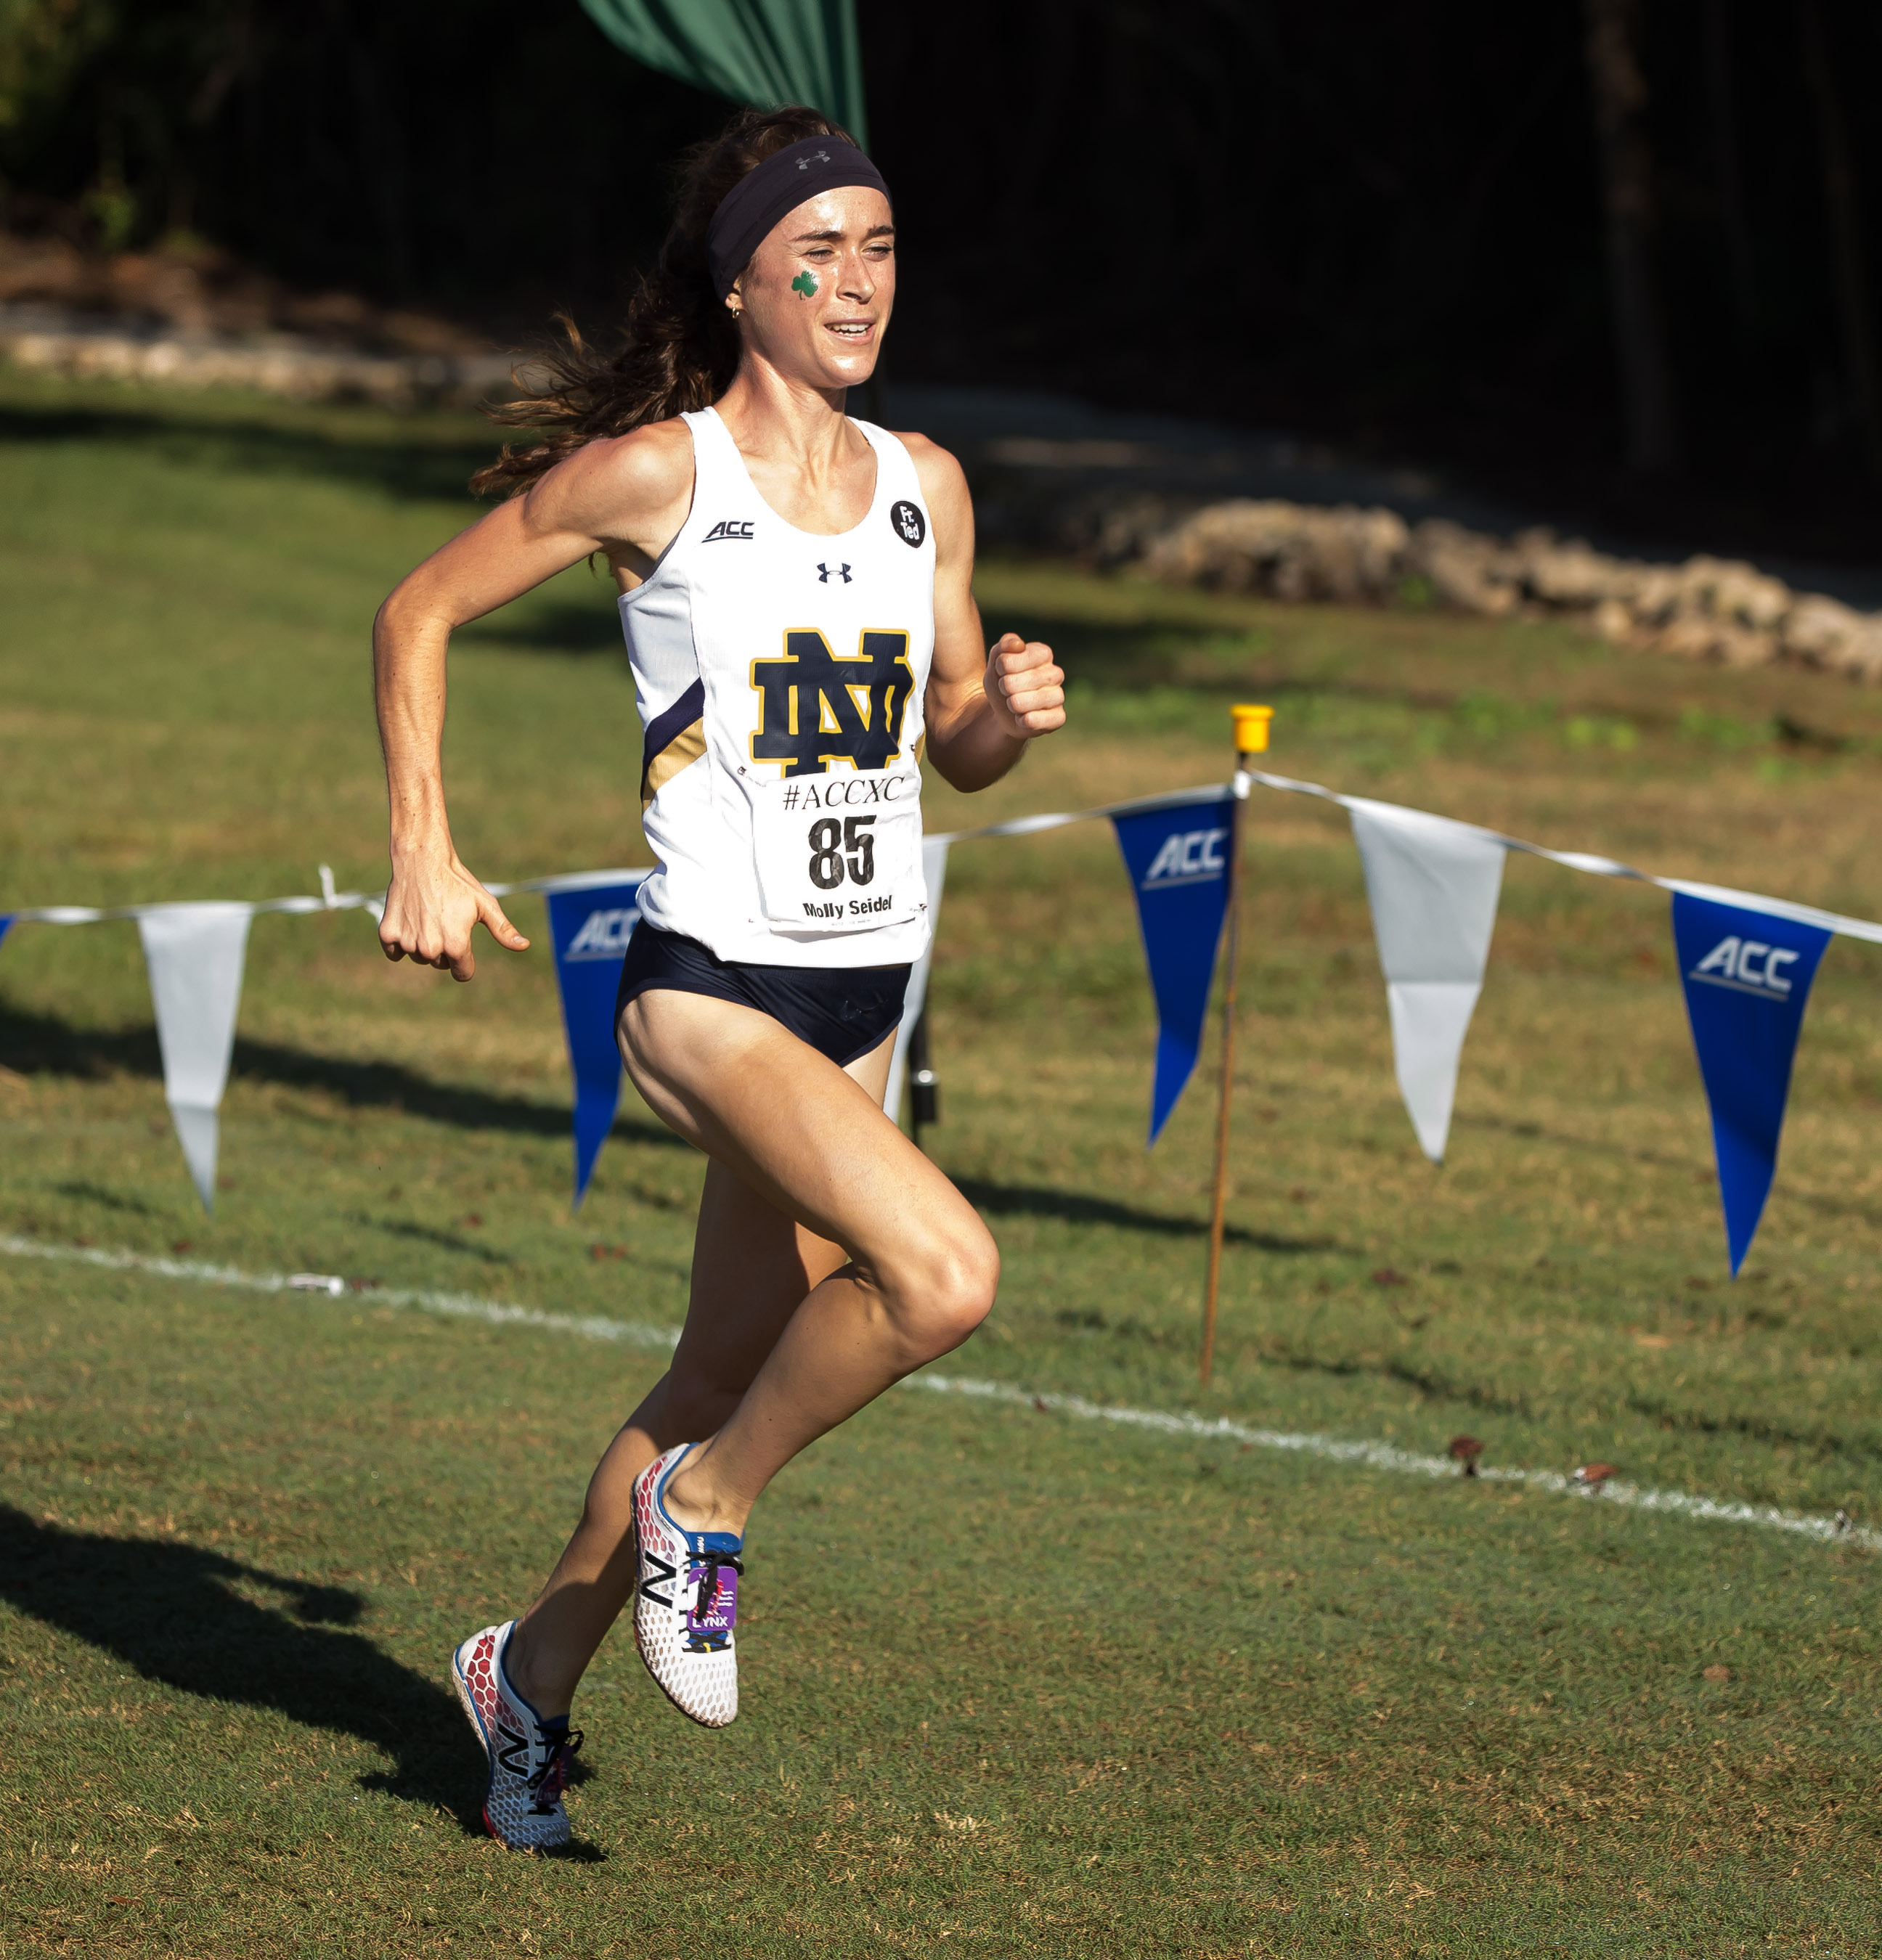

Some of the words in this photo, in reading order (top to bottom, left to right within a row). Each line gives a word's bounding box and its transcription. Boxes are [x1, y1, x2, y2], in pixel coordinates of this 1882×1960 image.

[705, 521, 754, 539] ACC
[900, 521, 920, 540] Ted
[783, 776, 905, 810] #ACCXC
[808, 814, 876, 890] 85
[1145, 828, 1229, 881] ACC
[803, 902, 844, 919] Molly
[850, 895, 892, 915] Seidel
[1696, 935, 1801, 993] ACC
[692, 1616, 728, 1628] LYNX
